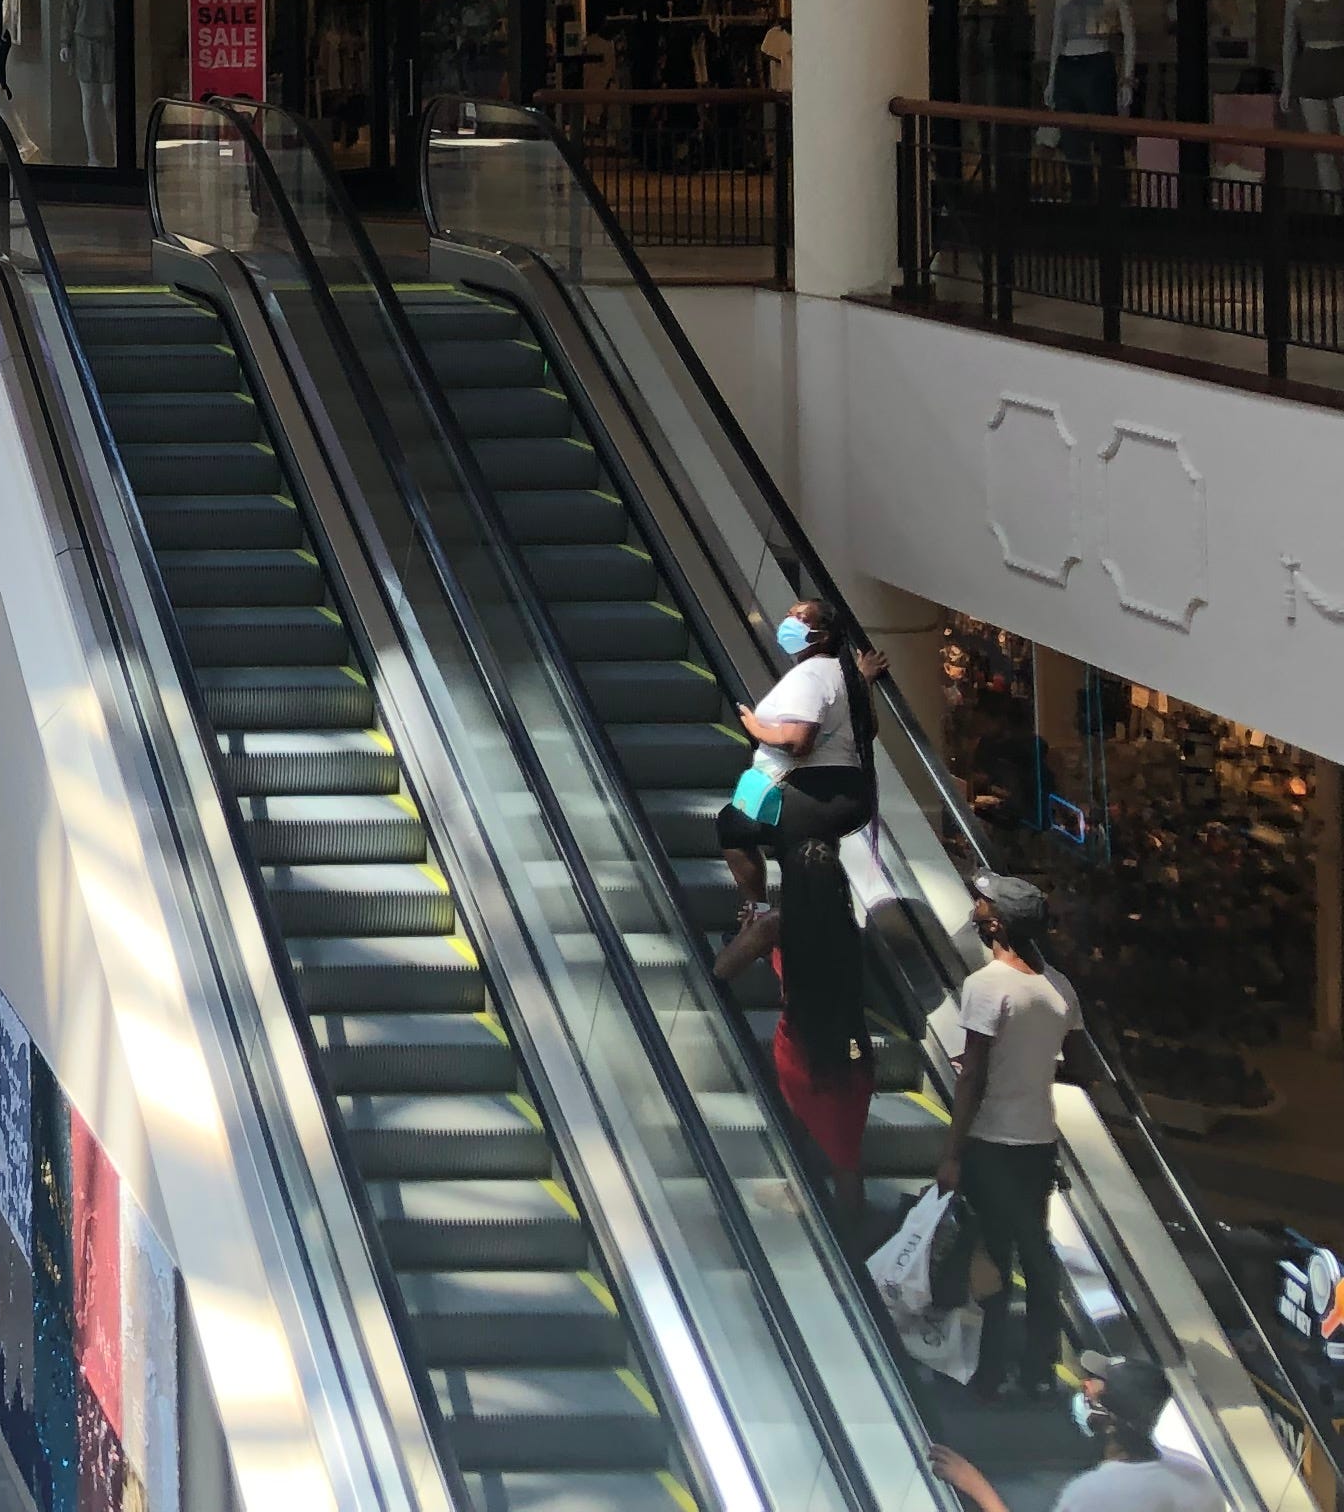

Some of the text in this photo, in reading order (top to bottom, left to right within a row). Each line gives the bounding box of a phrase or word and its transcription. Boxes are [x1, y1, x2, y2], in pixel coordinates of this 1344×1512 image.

[197, 6, 257, 25] SALE
[197, 27, 257, 47] SALE
[197, 48, 257, 69] SALE
